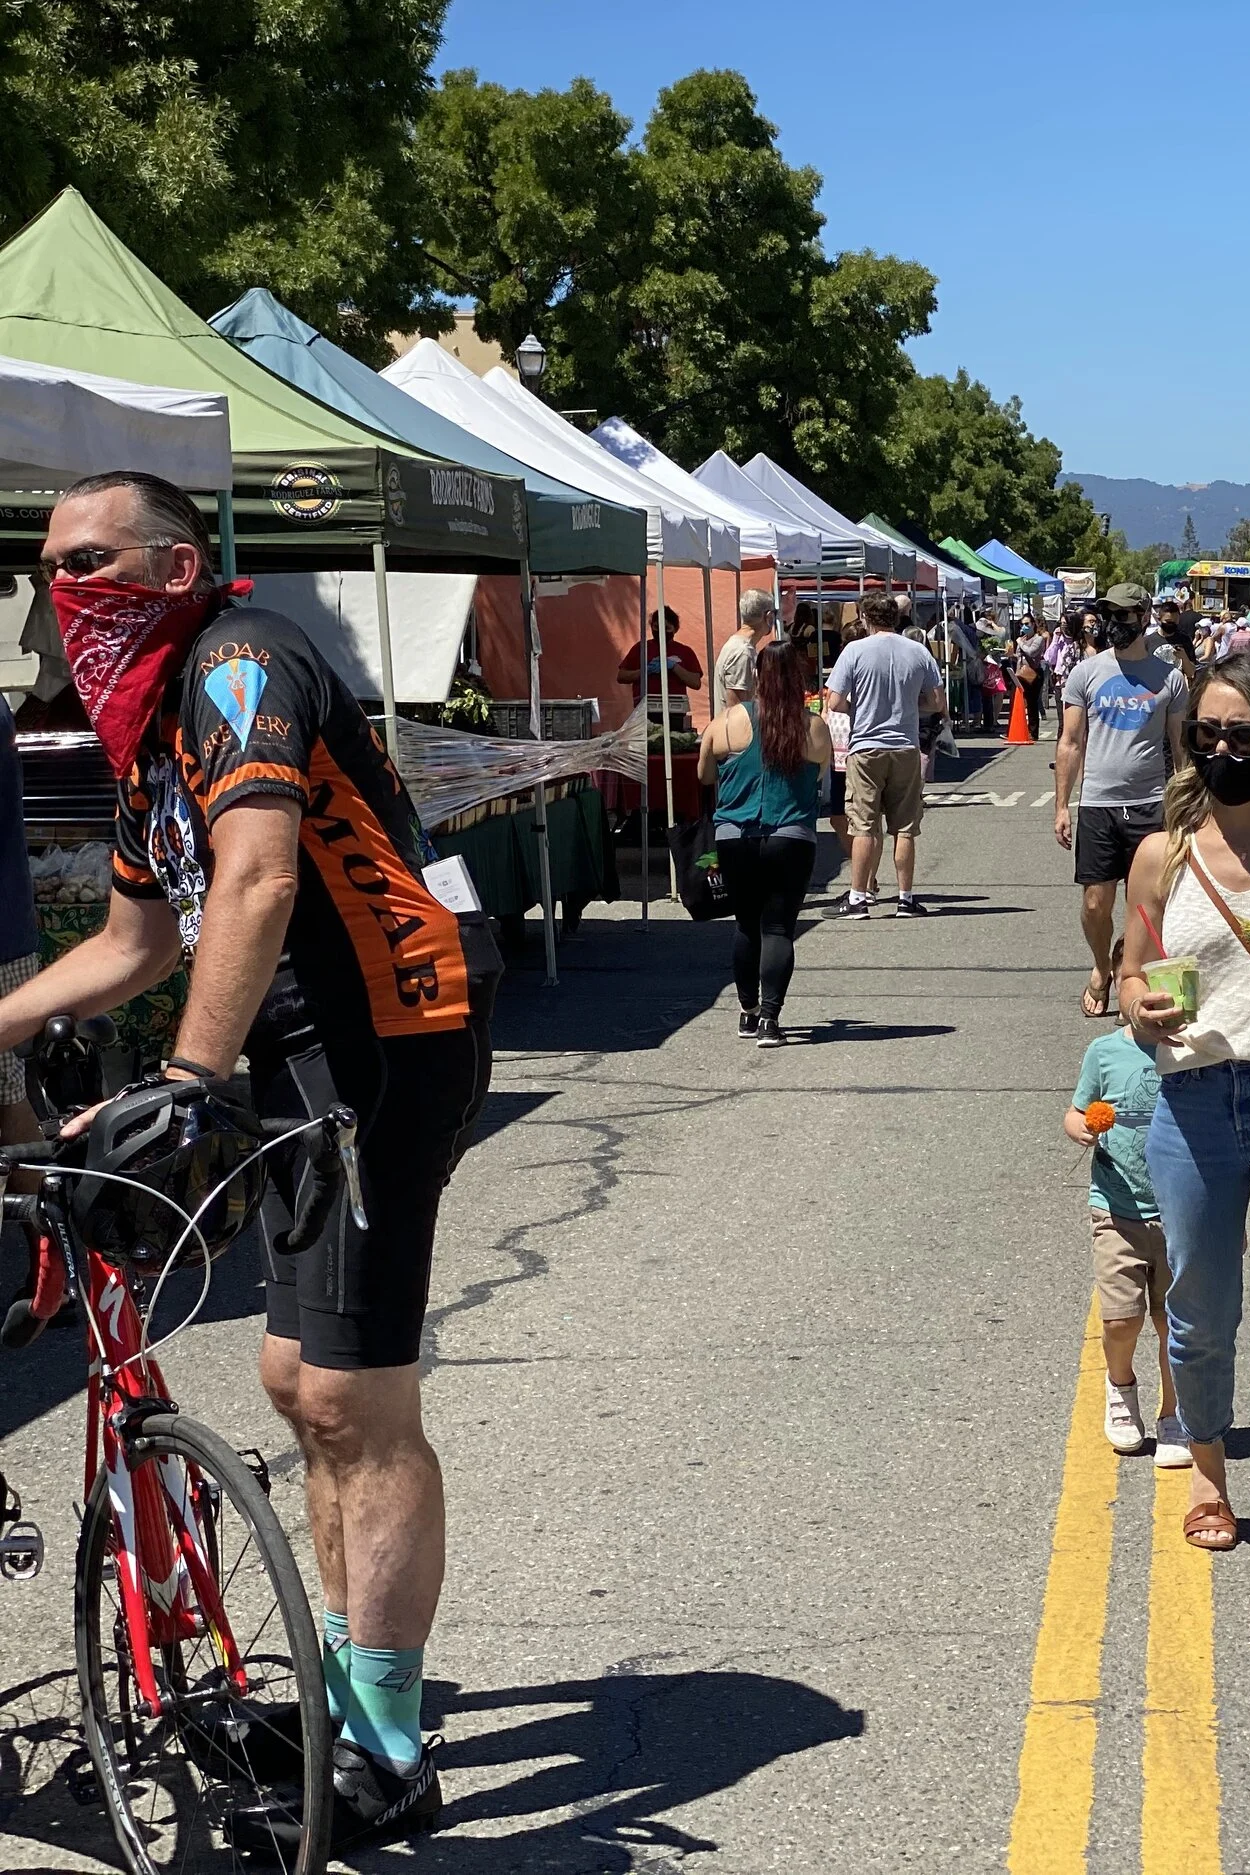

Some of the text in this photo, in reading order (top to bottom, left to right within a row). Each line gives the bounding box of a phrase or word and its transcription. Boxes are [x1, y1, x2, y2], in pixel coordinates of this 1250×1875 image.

[283, 501, 332, 519] CERTIFIED
[201, 642, 270, 675] MOAB
[1099, 695, 1151, 713] NASA
[300, 780, 440, 1008] MOAB
